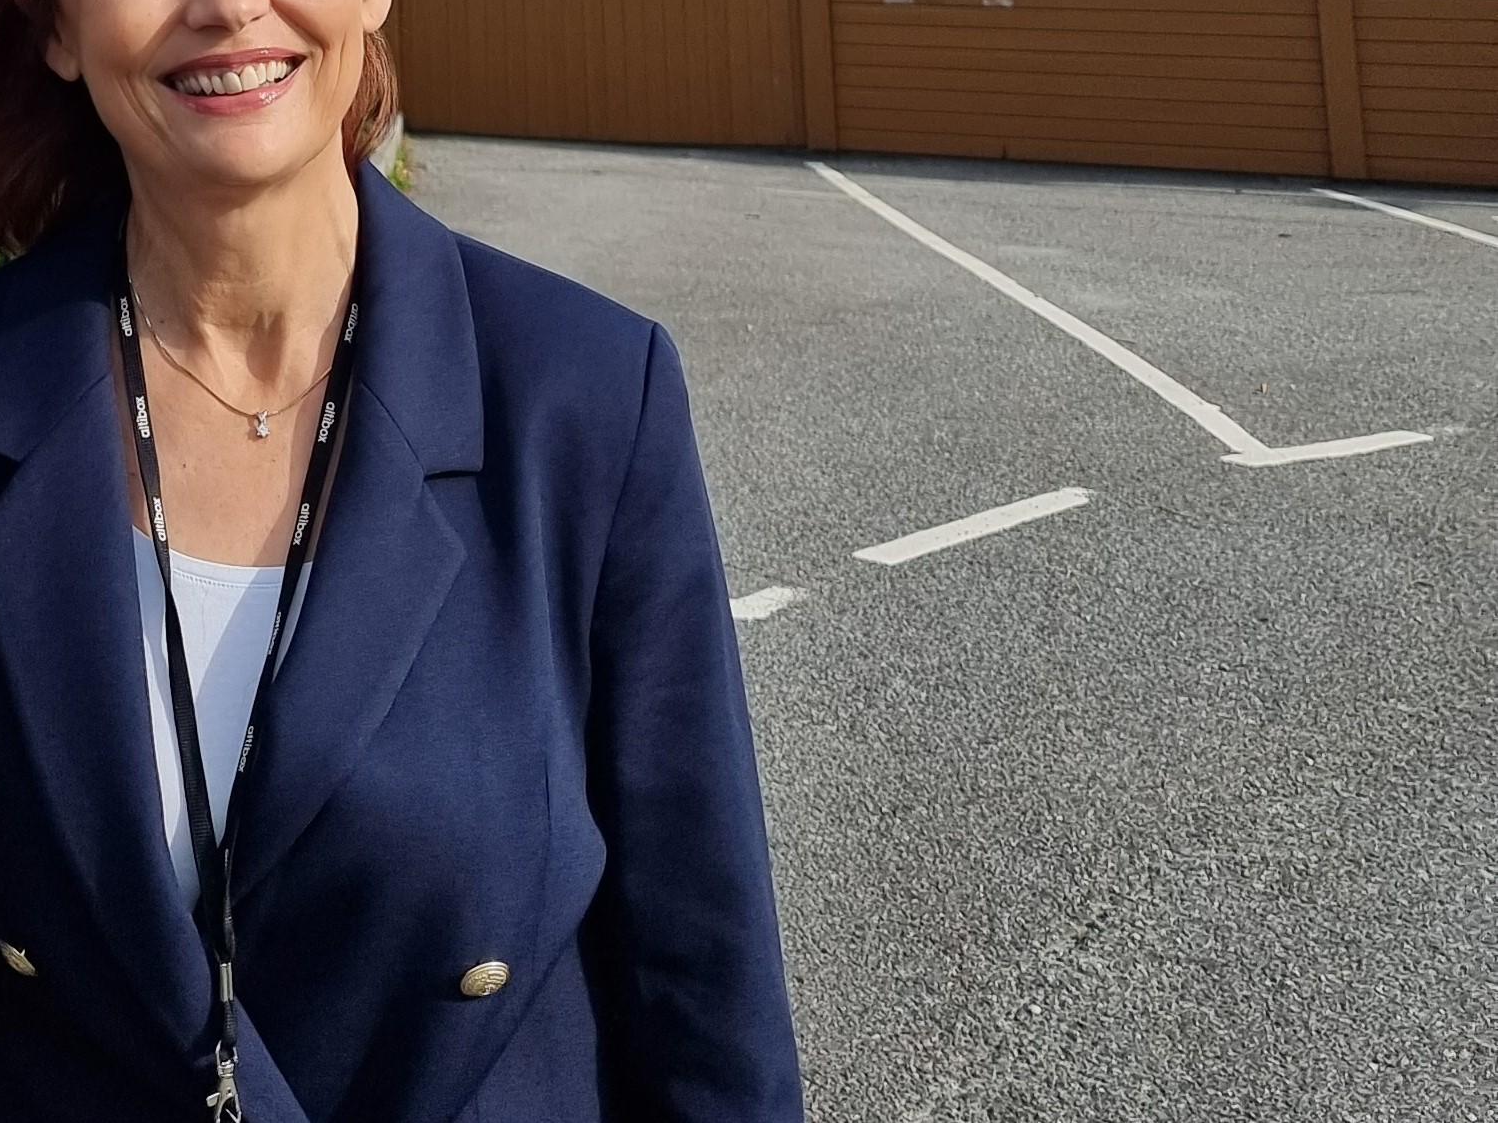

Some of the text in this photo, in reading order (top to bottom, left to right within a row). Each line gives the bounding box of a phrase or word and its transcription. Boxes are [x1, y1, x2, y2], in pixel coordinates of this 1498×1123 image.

[119, 297, 133, 337] altibox
[135, 395, 151, 439] altibox
[317, 400, 335, 443] altibox
[153, 496, 167, 542] altibox
[292, 502, 310, 546] altibox
